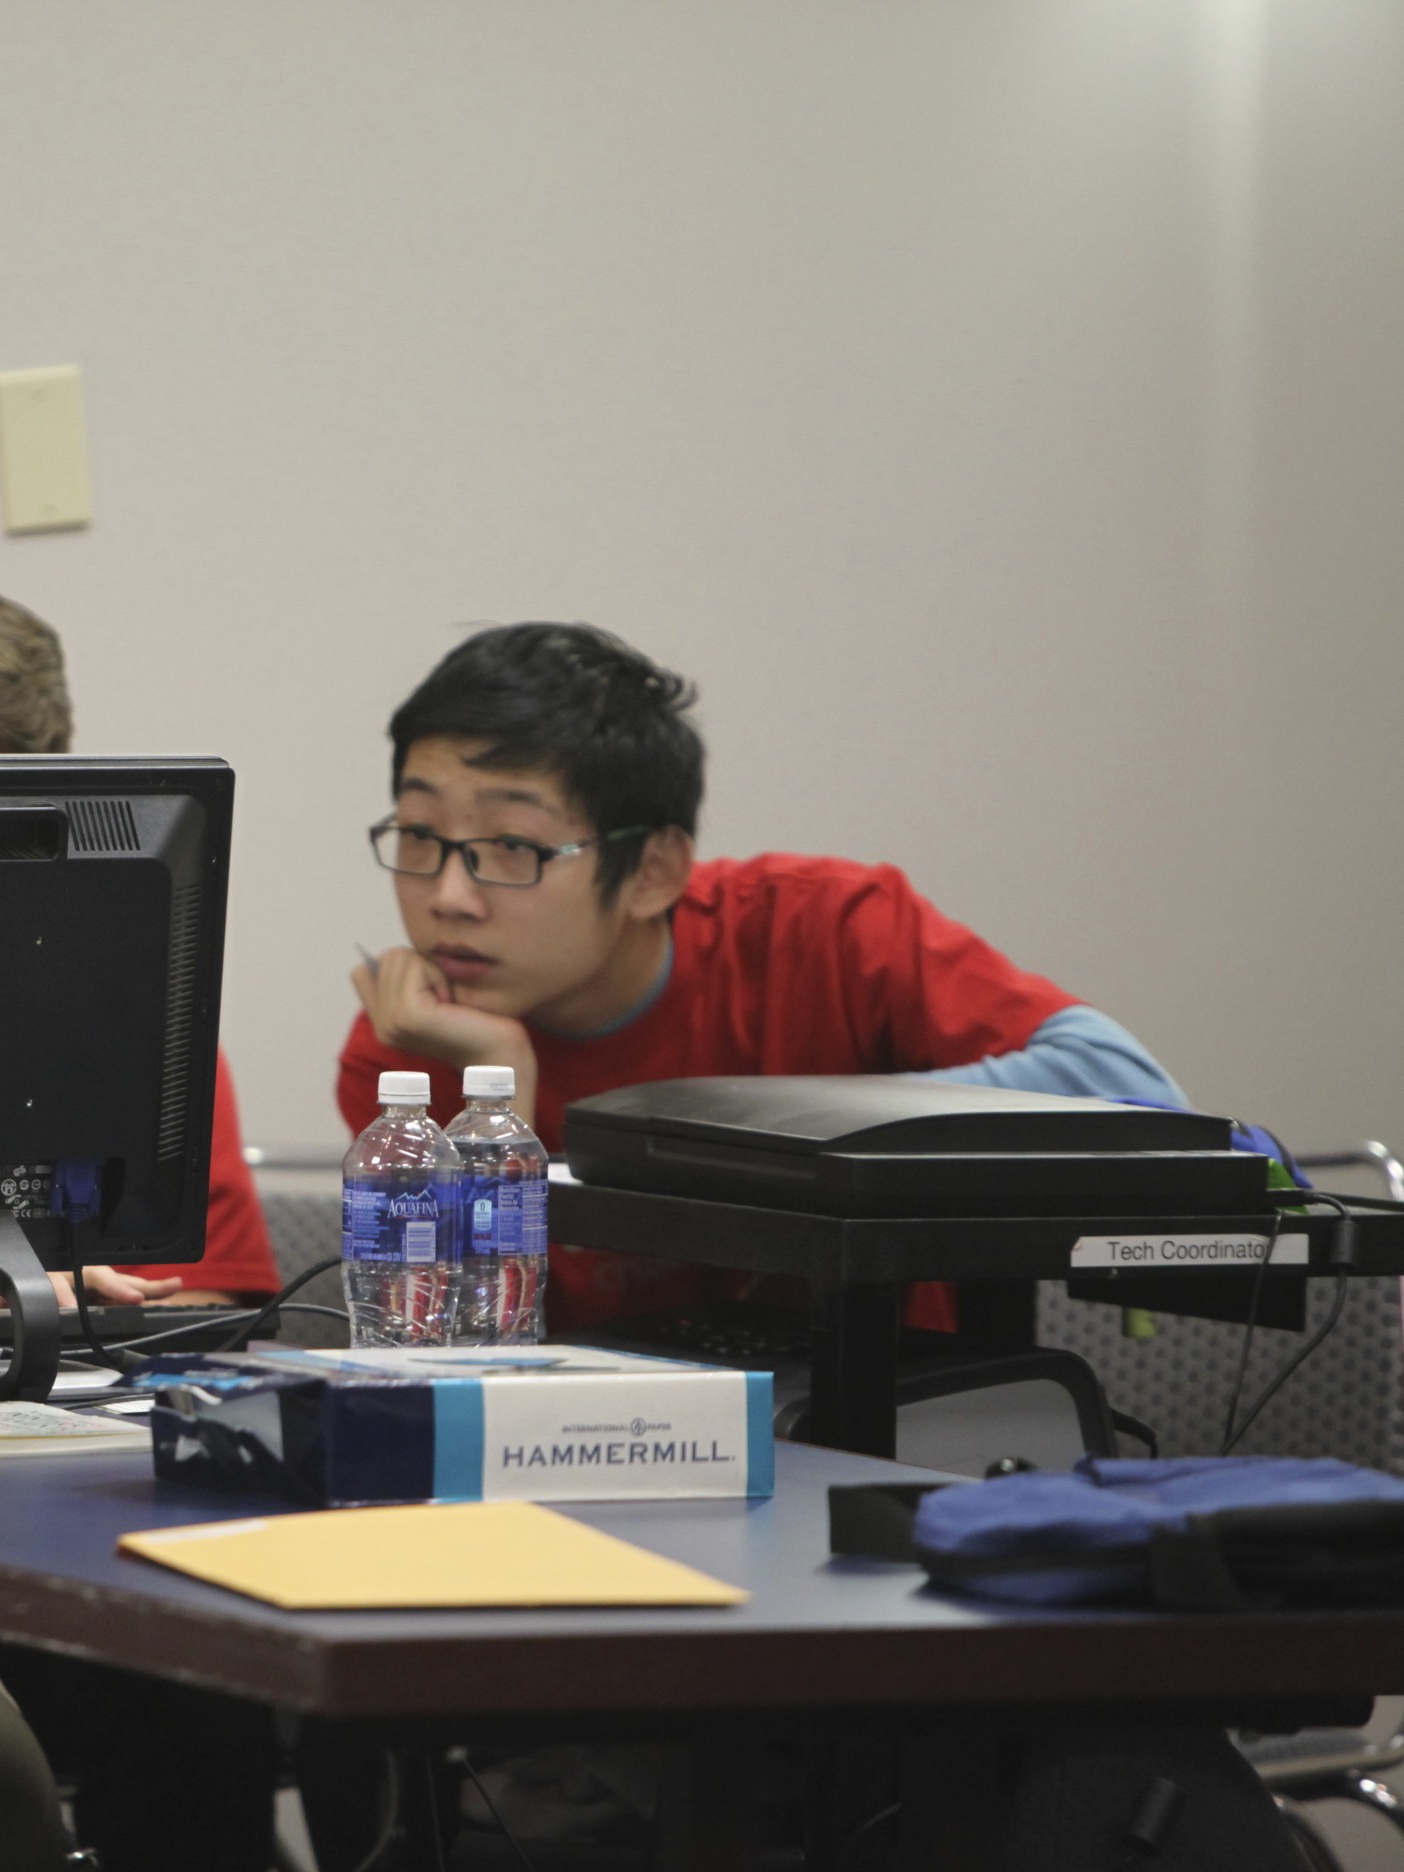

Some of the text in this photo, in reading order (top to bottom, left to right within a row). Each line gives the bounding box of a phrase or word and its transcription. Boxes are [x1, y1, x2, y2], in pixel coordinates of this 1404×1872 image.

[387, 1199, 439, 1218] AQUAFINA
[1107, 1239, 1270, 1260] Tech Coordinato
